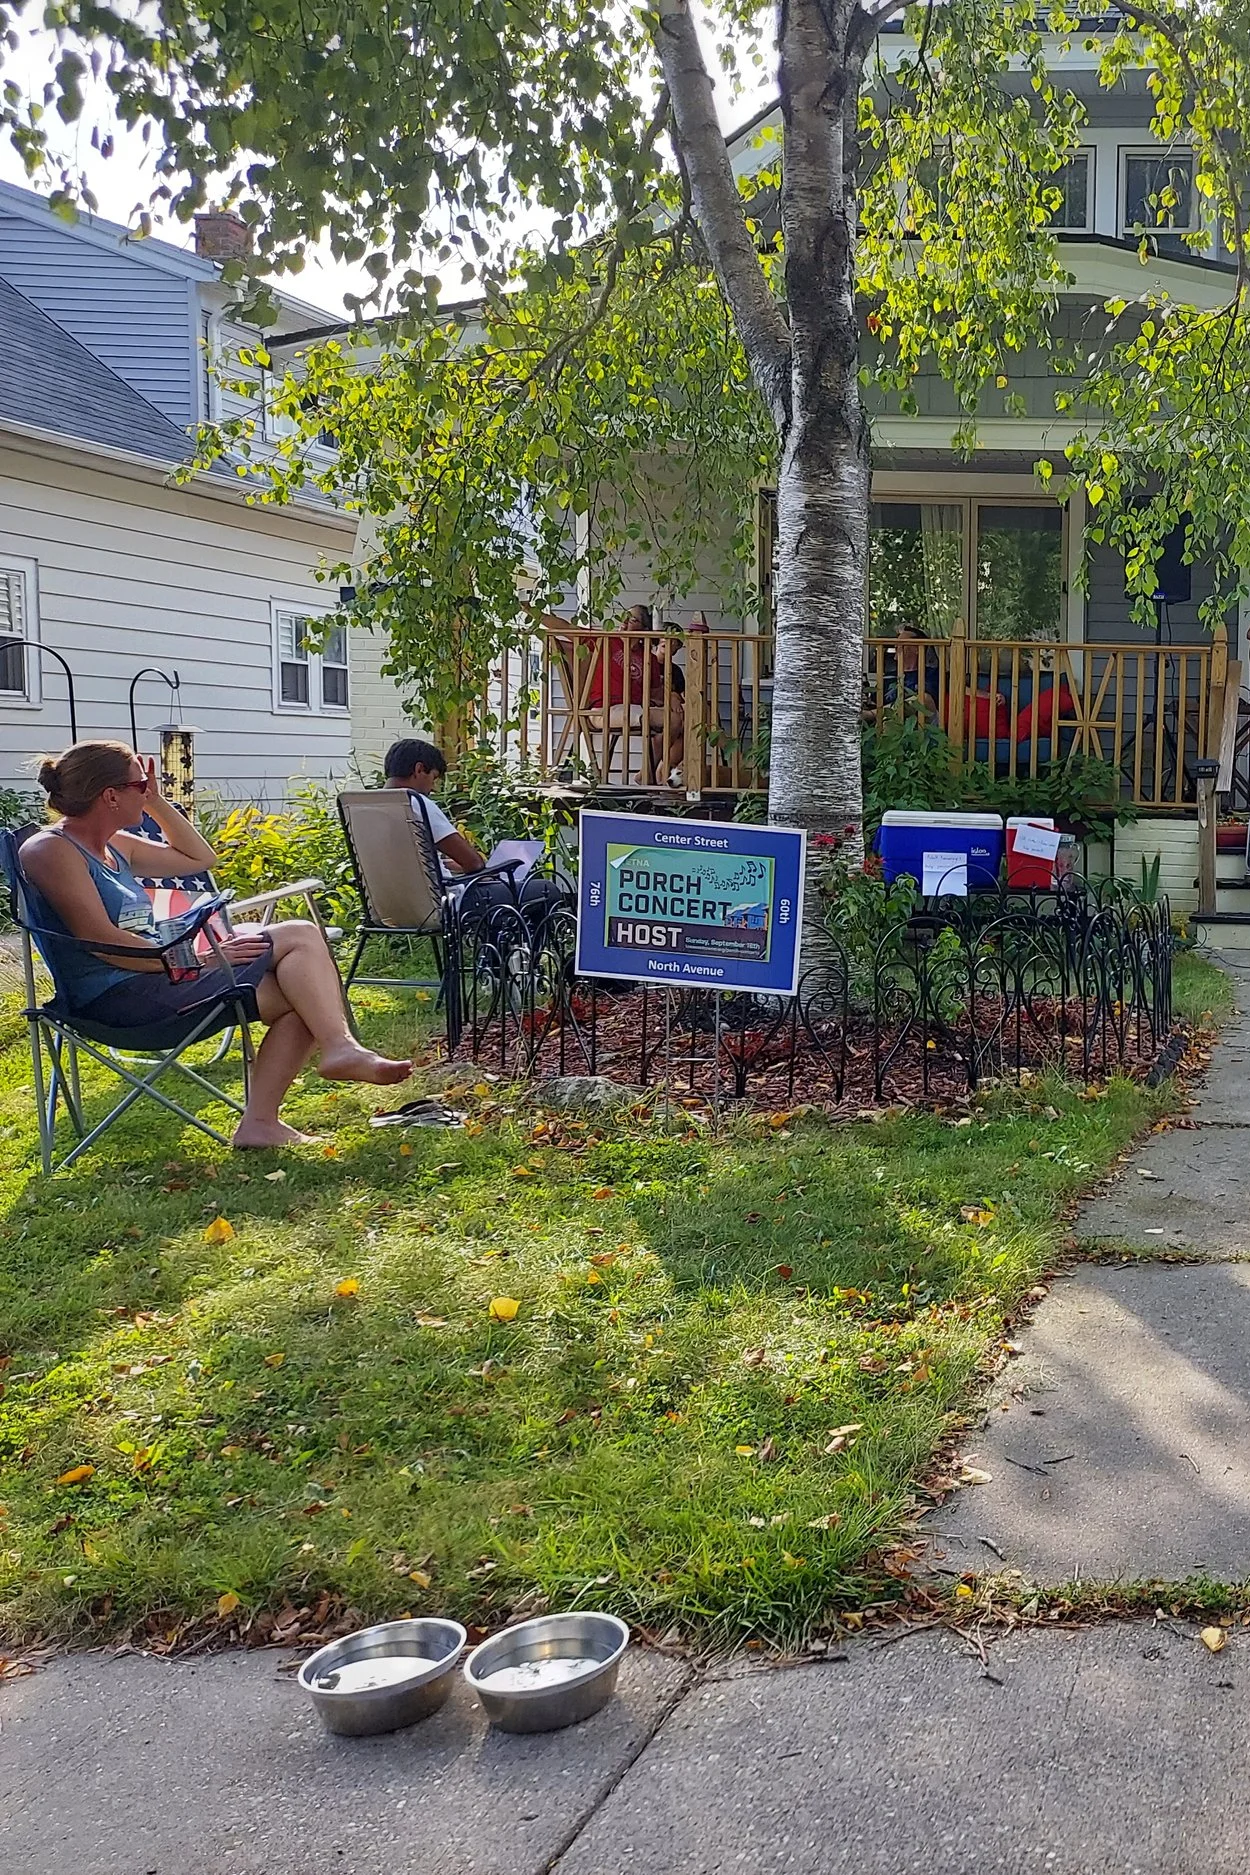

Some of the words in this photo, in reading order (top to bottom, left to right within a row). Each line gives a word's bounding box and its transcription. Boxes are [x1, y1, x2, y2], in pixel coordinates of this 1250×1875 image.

[654, 832, 692, 846] Center
[694, 836, 729, 848] Street
[626, 858, 650, 867] ETNA
[590, 881, 601, 906] 76th
[619, 869, 701, 895] PORCH
[618, 893, 732, 920] CONCERT
[780, 898, 791, 924] 60th
[617, 923, 682, 947] HOST
[711, 940, 745, 948] September
[648, 960, 680, 973] North
[683, 964, 724, 976] Avenue
